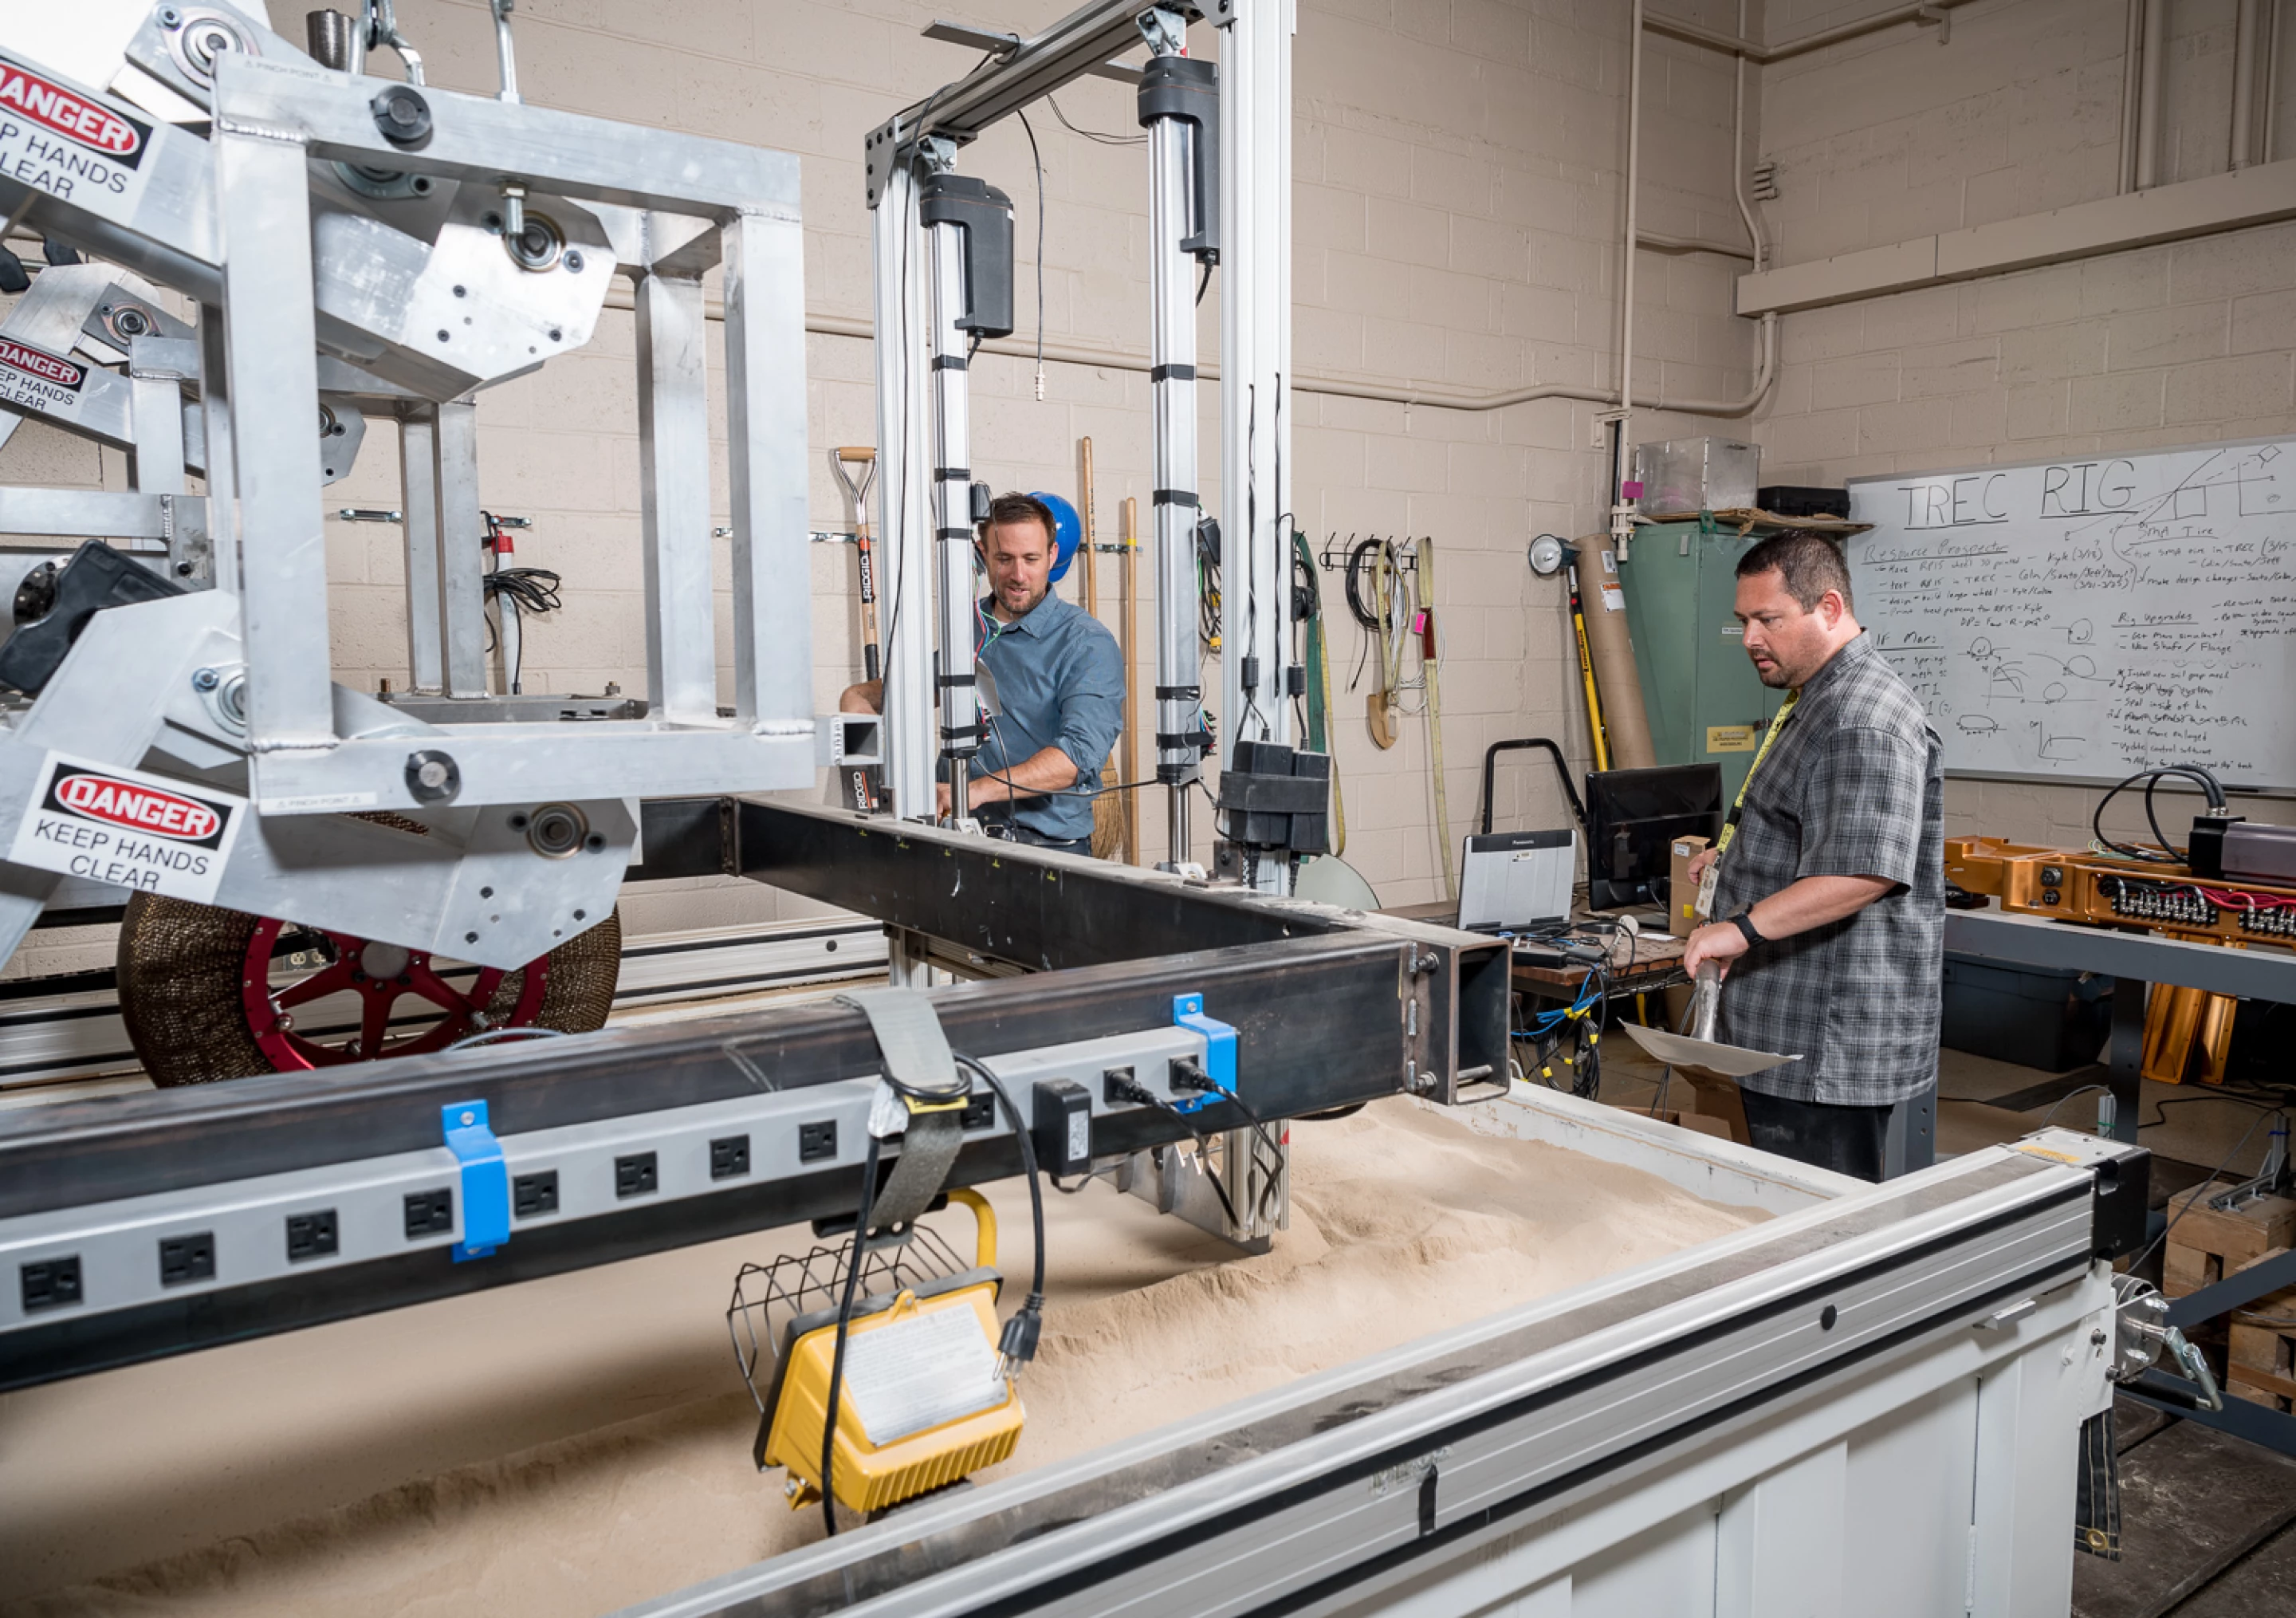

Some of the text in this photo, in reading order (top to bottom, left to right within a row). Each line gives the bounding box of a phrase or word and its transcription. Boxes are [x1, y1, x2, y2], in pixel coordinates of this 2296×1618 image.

[0, 67, 129, 152] ANGER
[0, 151, 74, 199] LEAR
[26, 134, 128, 193] HANDS
[20, 377, 75, 406] HANDS
[1897, 459, 2136, 526] TREC RIG
[2180, 526, 2215, 537] Tire
[860, 553, 872, 600] RIDGID
[66, 779, 212, 836] DANGER
[853, 771, 868, 809] RIDGID
[34, 818, 210, 876] KEEP HANDS
[69, 855, 160, 891] CLEAR
